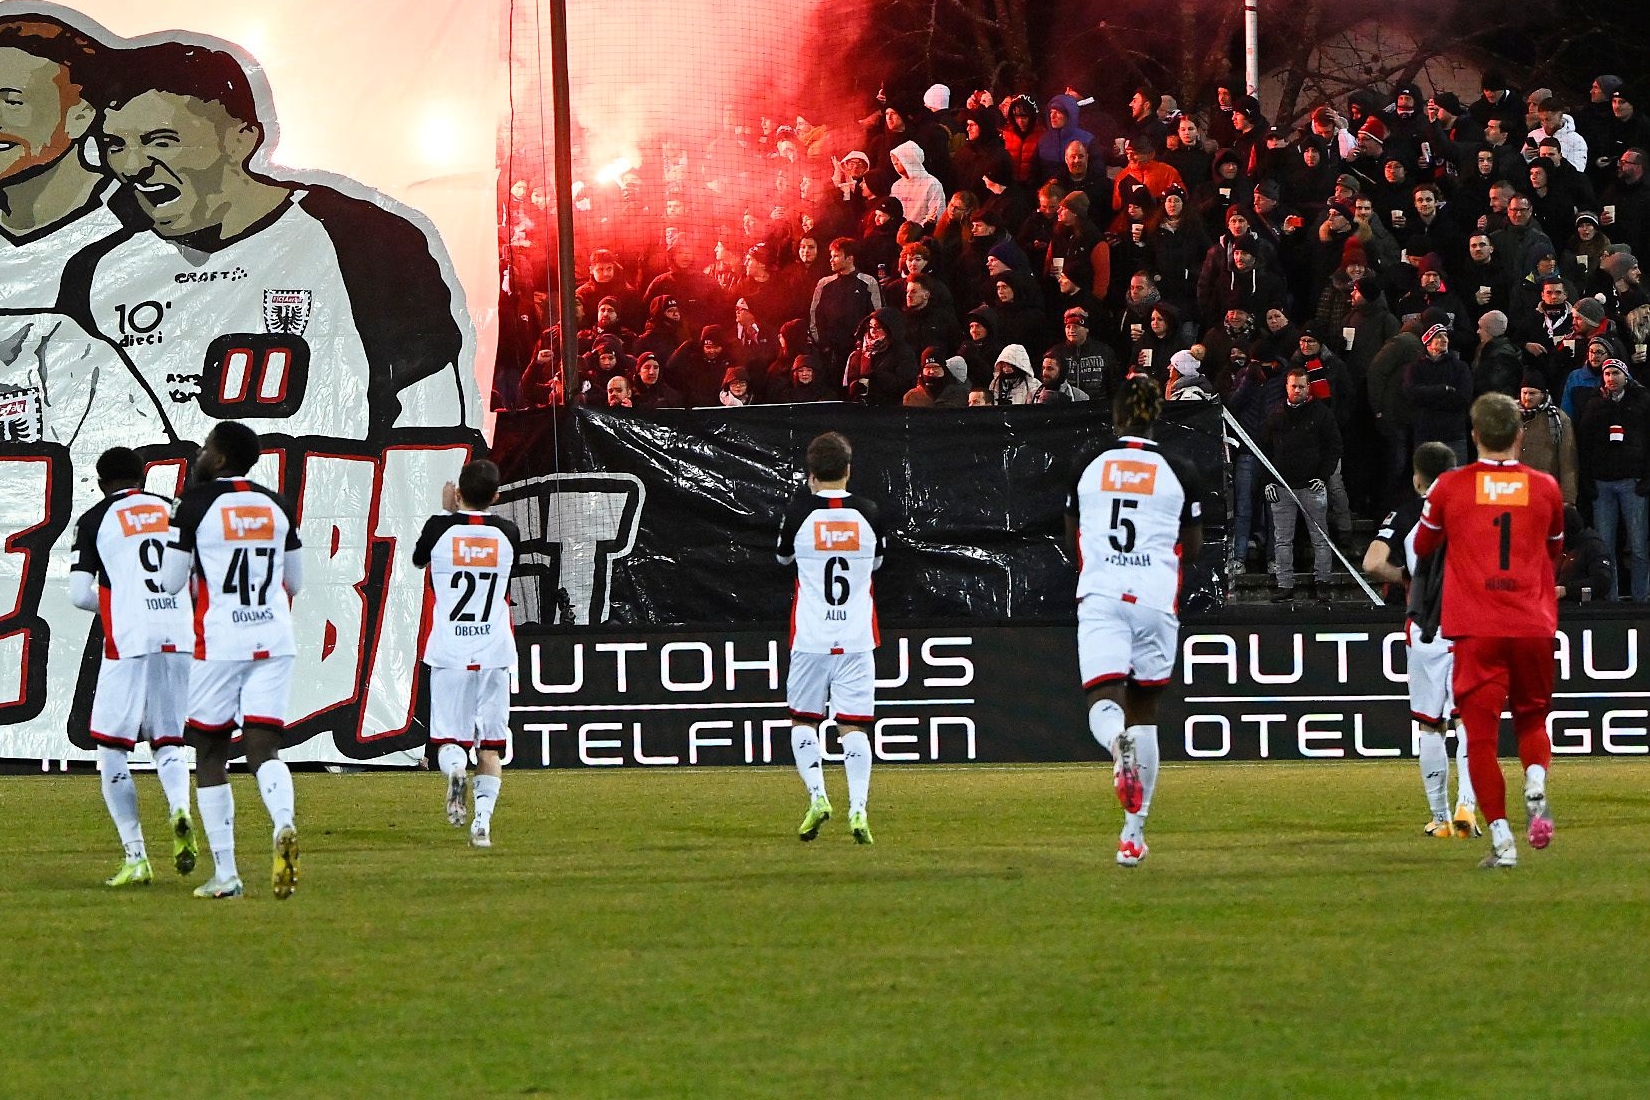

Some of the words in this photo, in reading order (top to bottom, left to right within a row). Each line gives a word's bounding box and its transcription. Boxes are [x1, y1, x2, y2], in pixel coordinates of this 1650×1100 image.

[174, 271, 230, 284] CRAFT
[119, 330, 163, 348] dieci
[1109, 463, 1151, 490] hrs
[1483, 475, 1523, 501] hrs
[123, 509, 164, 532] hrs
[228, 509, 269, 538] hrs
[819, 524, 855, 549] hrs
[1107, 498, 1138, 554] 5
[458, 539, 495, 564] hrs
[1492, 511, 1512, 571] 1
[138, 538, 166, 594] 9
[222, 548, 277, 606] 47
[824, 556, 850, 607] 6
[449, 570, 498, 622] 27
[825, 609, 847, 621] ALIU
[455, 624, 492, 637] OBEXER
[510, 636, 975, 695] UTOHUS
[1183, 627, 1639, 685] AUTU
[500, 715, 977, 766] TELFINGEN
[1183, 708, 1650, 758] OTELGE
